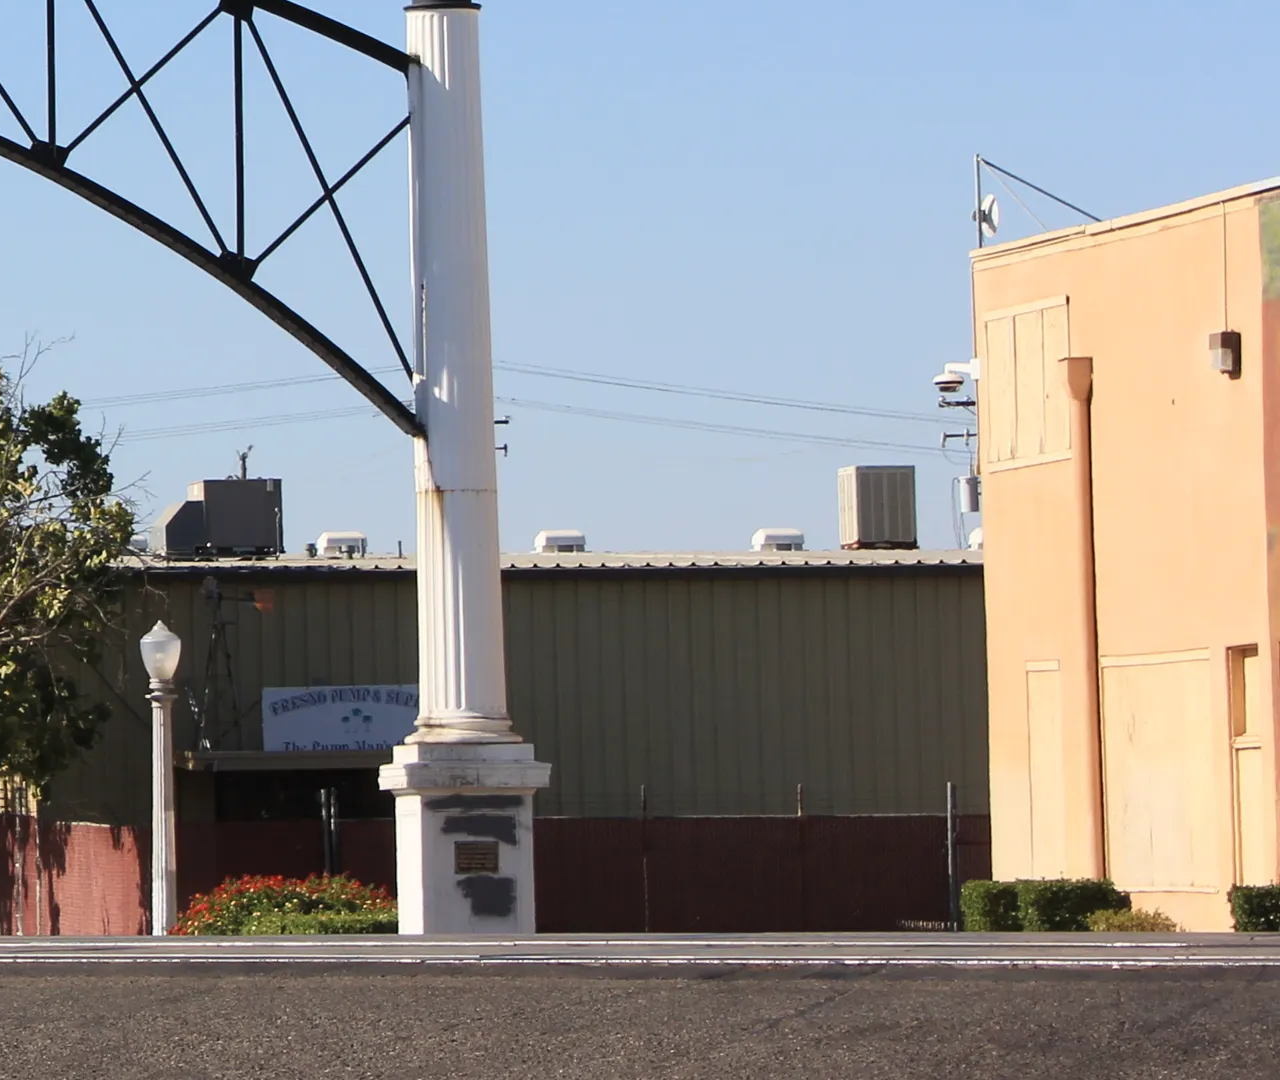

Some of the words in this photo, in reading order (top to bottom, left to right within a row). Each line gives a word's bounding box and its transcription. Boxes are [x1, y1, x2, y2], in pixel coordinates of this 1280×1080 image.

[269, 690, 327, 717] FRESNO
[330, 687, 371, 704] PUMP
[371, 688, 382, 704] &
